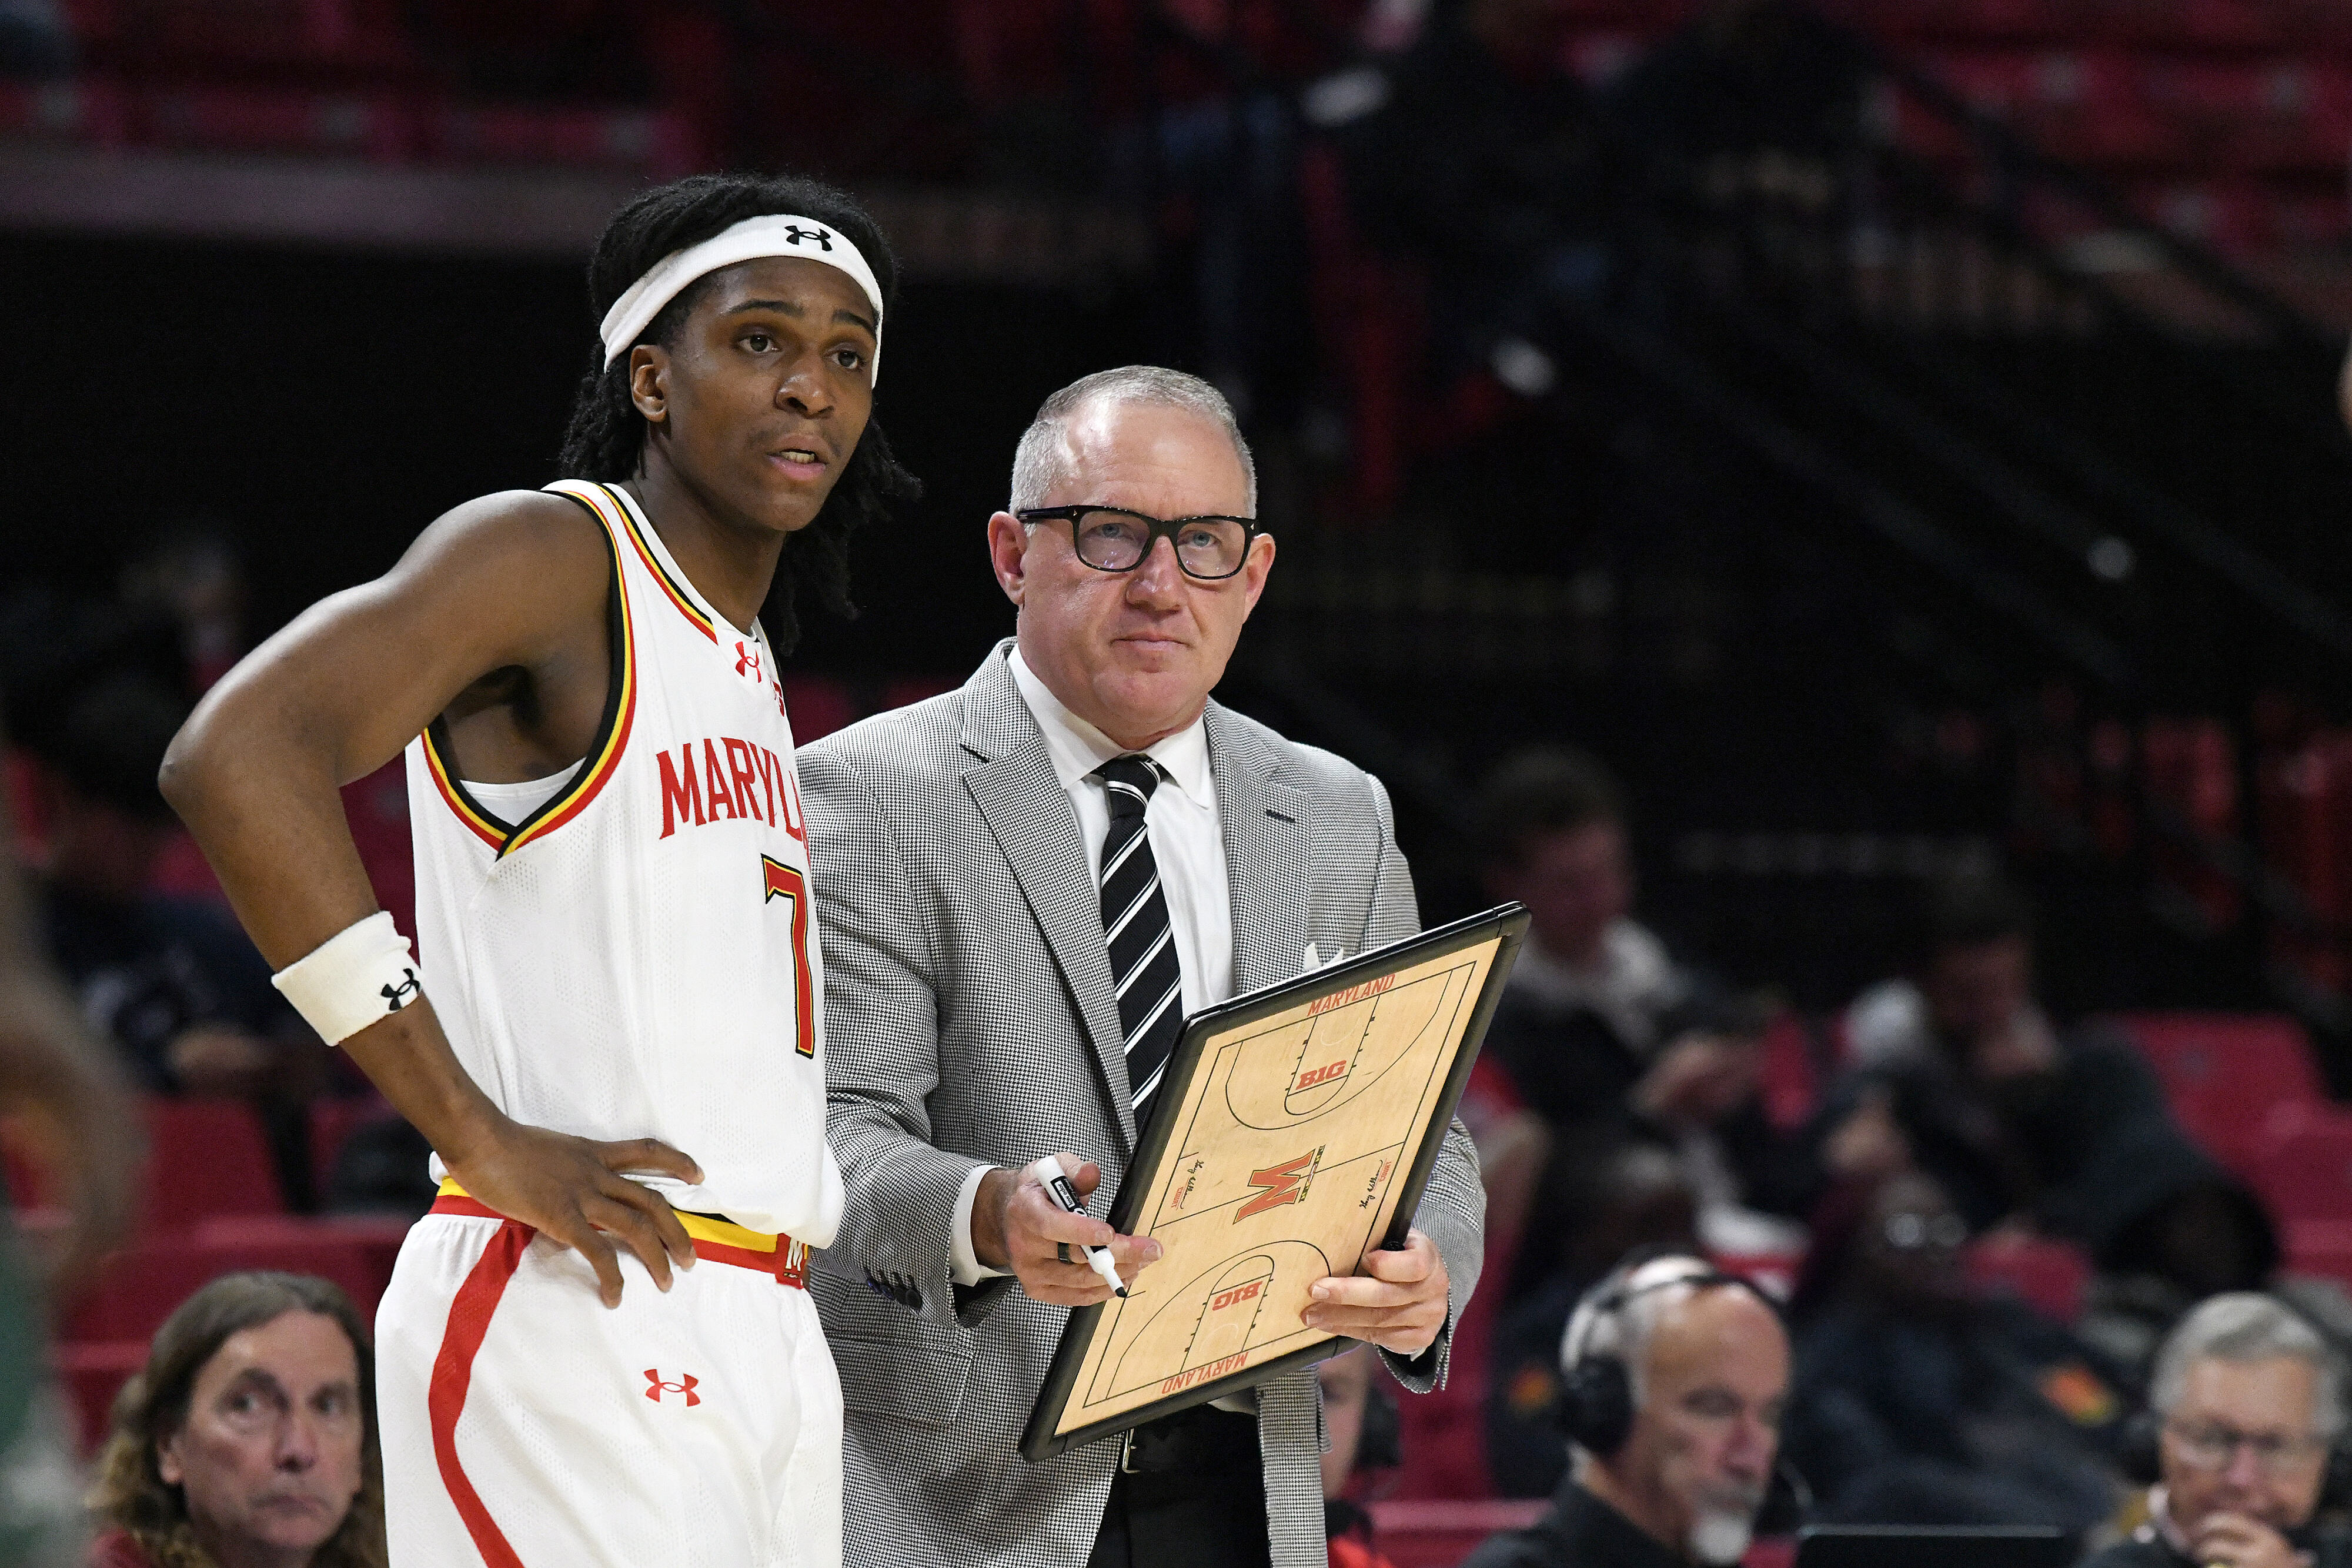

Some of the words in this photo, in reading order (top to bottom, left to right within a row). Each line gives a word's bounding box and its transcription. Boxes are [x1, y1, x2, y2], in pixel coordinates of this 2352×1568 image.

[656, 737, 810, 865] MARYL
[761, 853, 815, 1059] 7
[1307, 974, 1396, 1017] MARYLAND
[1058, 1183, 1068, 1195] odor
[1161, 1352, 1250, 1394] MARYLAND
